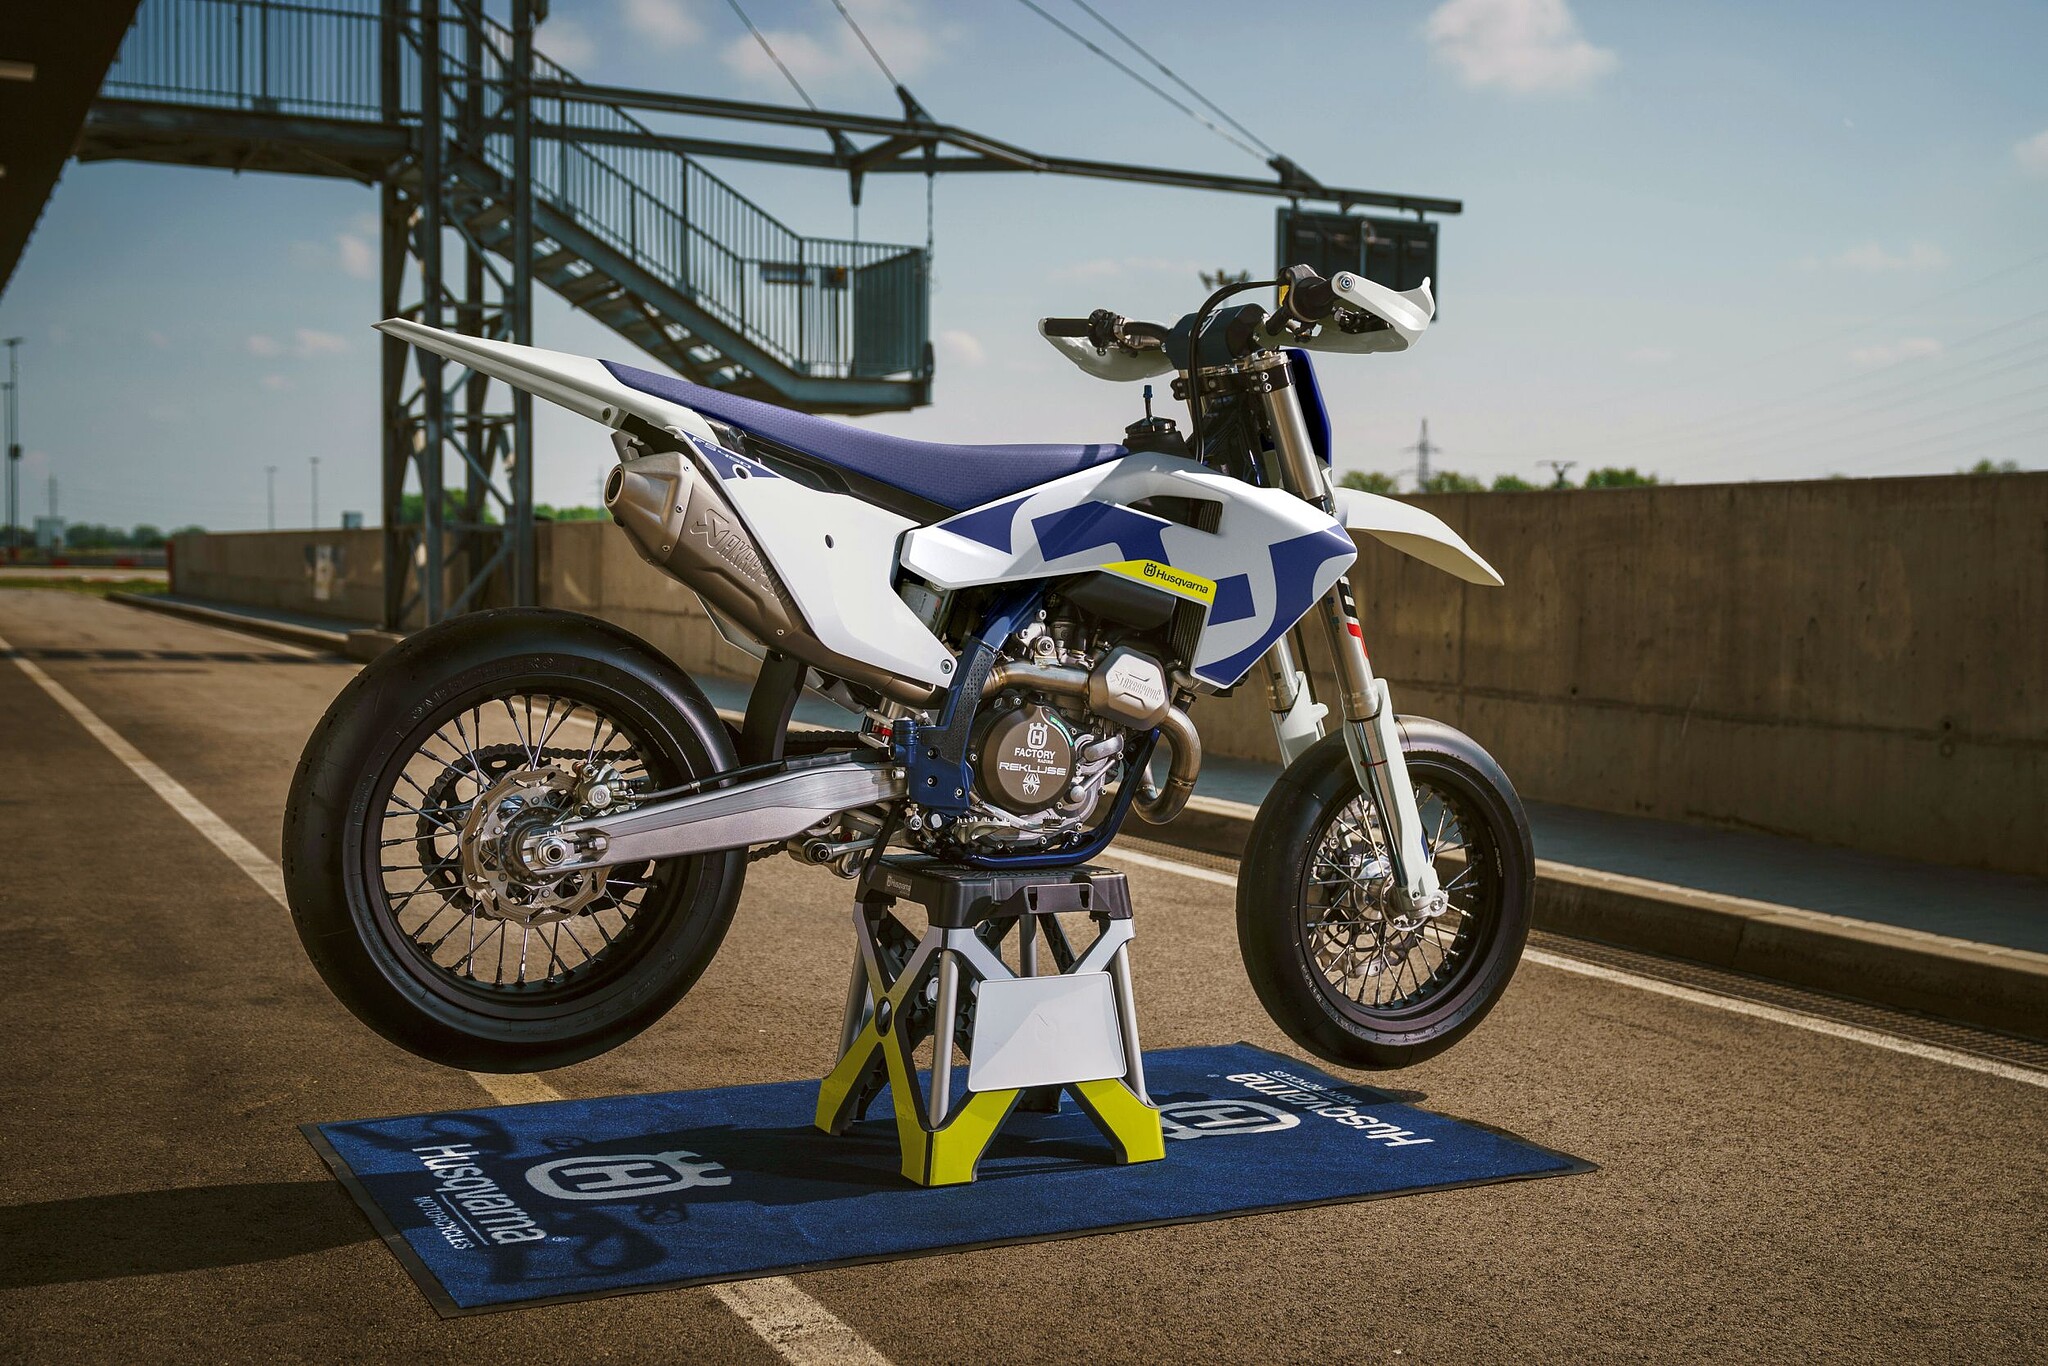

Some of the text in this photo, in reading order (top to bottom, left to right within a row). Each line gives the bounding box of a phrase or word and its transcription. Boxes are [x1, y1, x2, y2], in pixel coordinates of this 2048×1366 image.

[1156, 569, 1209, 594] Husqvarna
[999, 761, 1067, 776] REKLUSE
[1014, 747, 1056, 760] FACTORY
[1226, 1073, 1435, 1147] Husqvarna
[412, 1143, 548, 1245] Husqvarna
[413, 1196, 475, 1250] MOTORCYCLES
